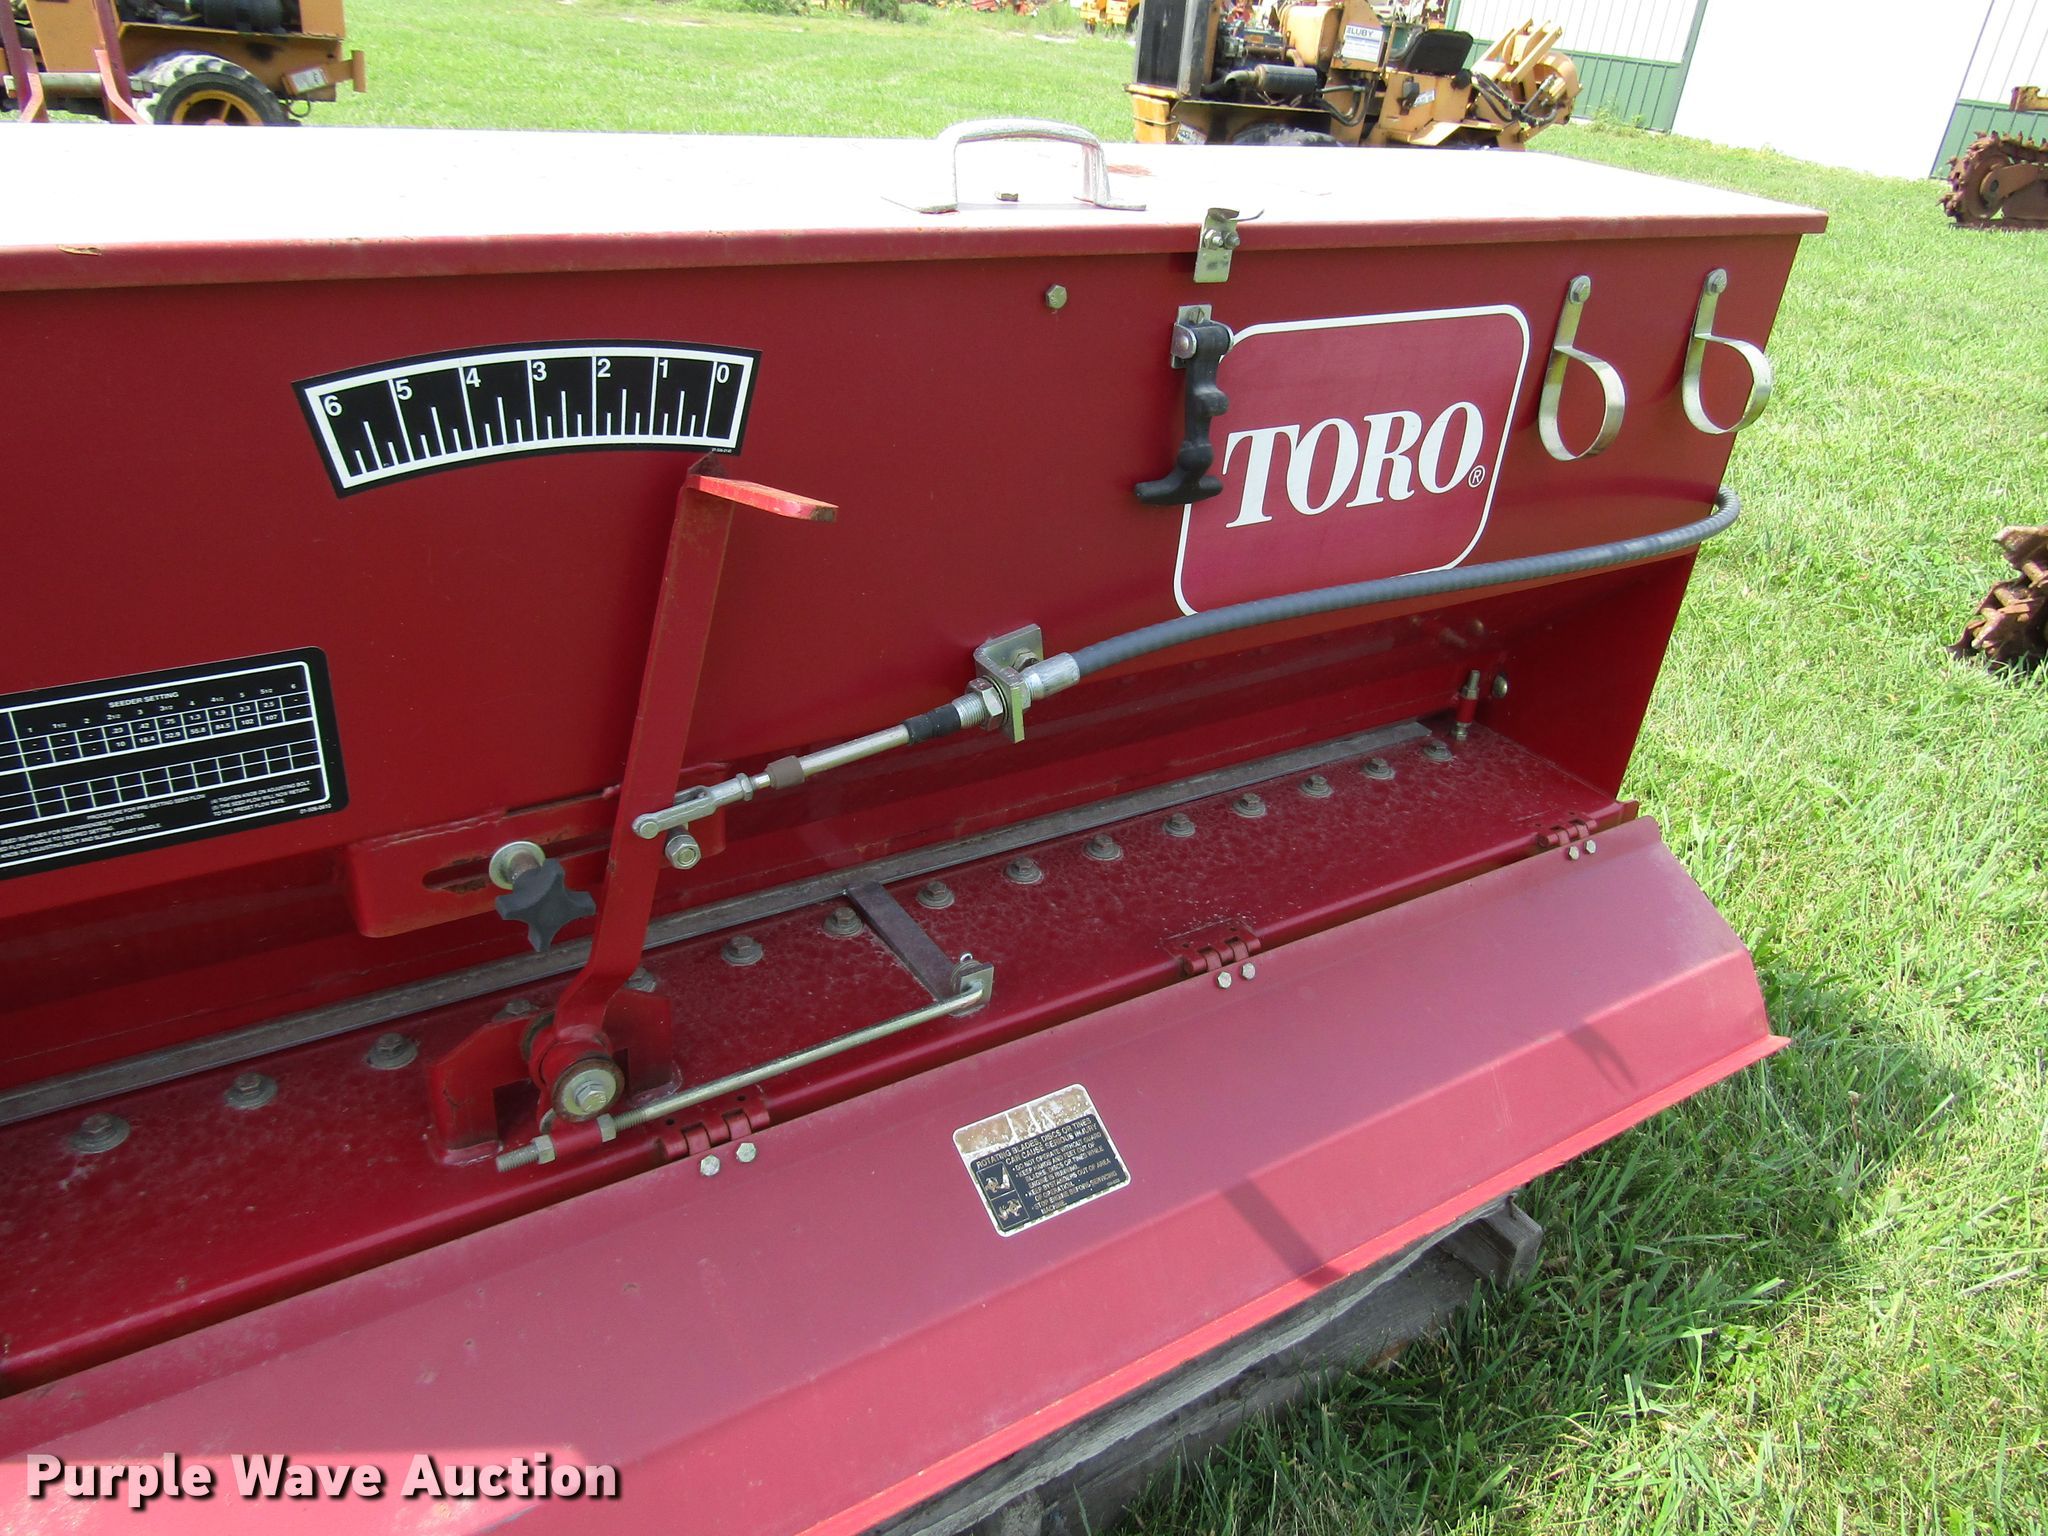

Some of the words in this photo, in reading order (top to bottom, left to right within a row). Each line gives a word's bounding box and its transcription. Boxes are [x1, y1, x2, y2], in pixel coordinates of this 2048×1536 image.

[323, 396, 343, 417] 6
[396, 378, 413, 400] 5
[465, 367, 481, 387] 4
[532, 361, 547, 381] 3
[597, 358, 611, 378] 2
[659, 359, 669, 379] 1
[715, 364, 730, 384] 0
[1222, 401, 1485, 528] TORO
[108, 697, 143, 708] SEEDER
[144, 692, 178, 702] SETTING
[976, 1150, 1012, 1169] ROTATING
[1041, 1130, 1062, 1141] DISCS
[1072, 1118, 1092, 1129] TINES
[1005, 1154, 1022, 1165] CAN
[1022, 1145, 1045, 1158] CAUSE
[1044, 1133, 1074, 1149] SERIOUS
[1073, 1123, 1098, 1137] INJURY
[1036, 1149, 1061, 1161] OPERATE
